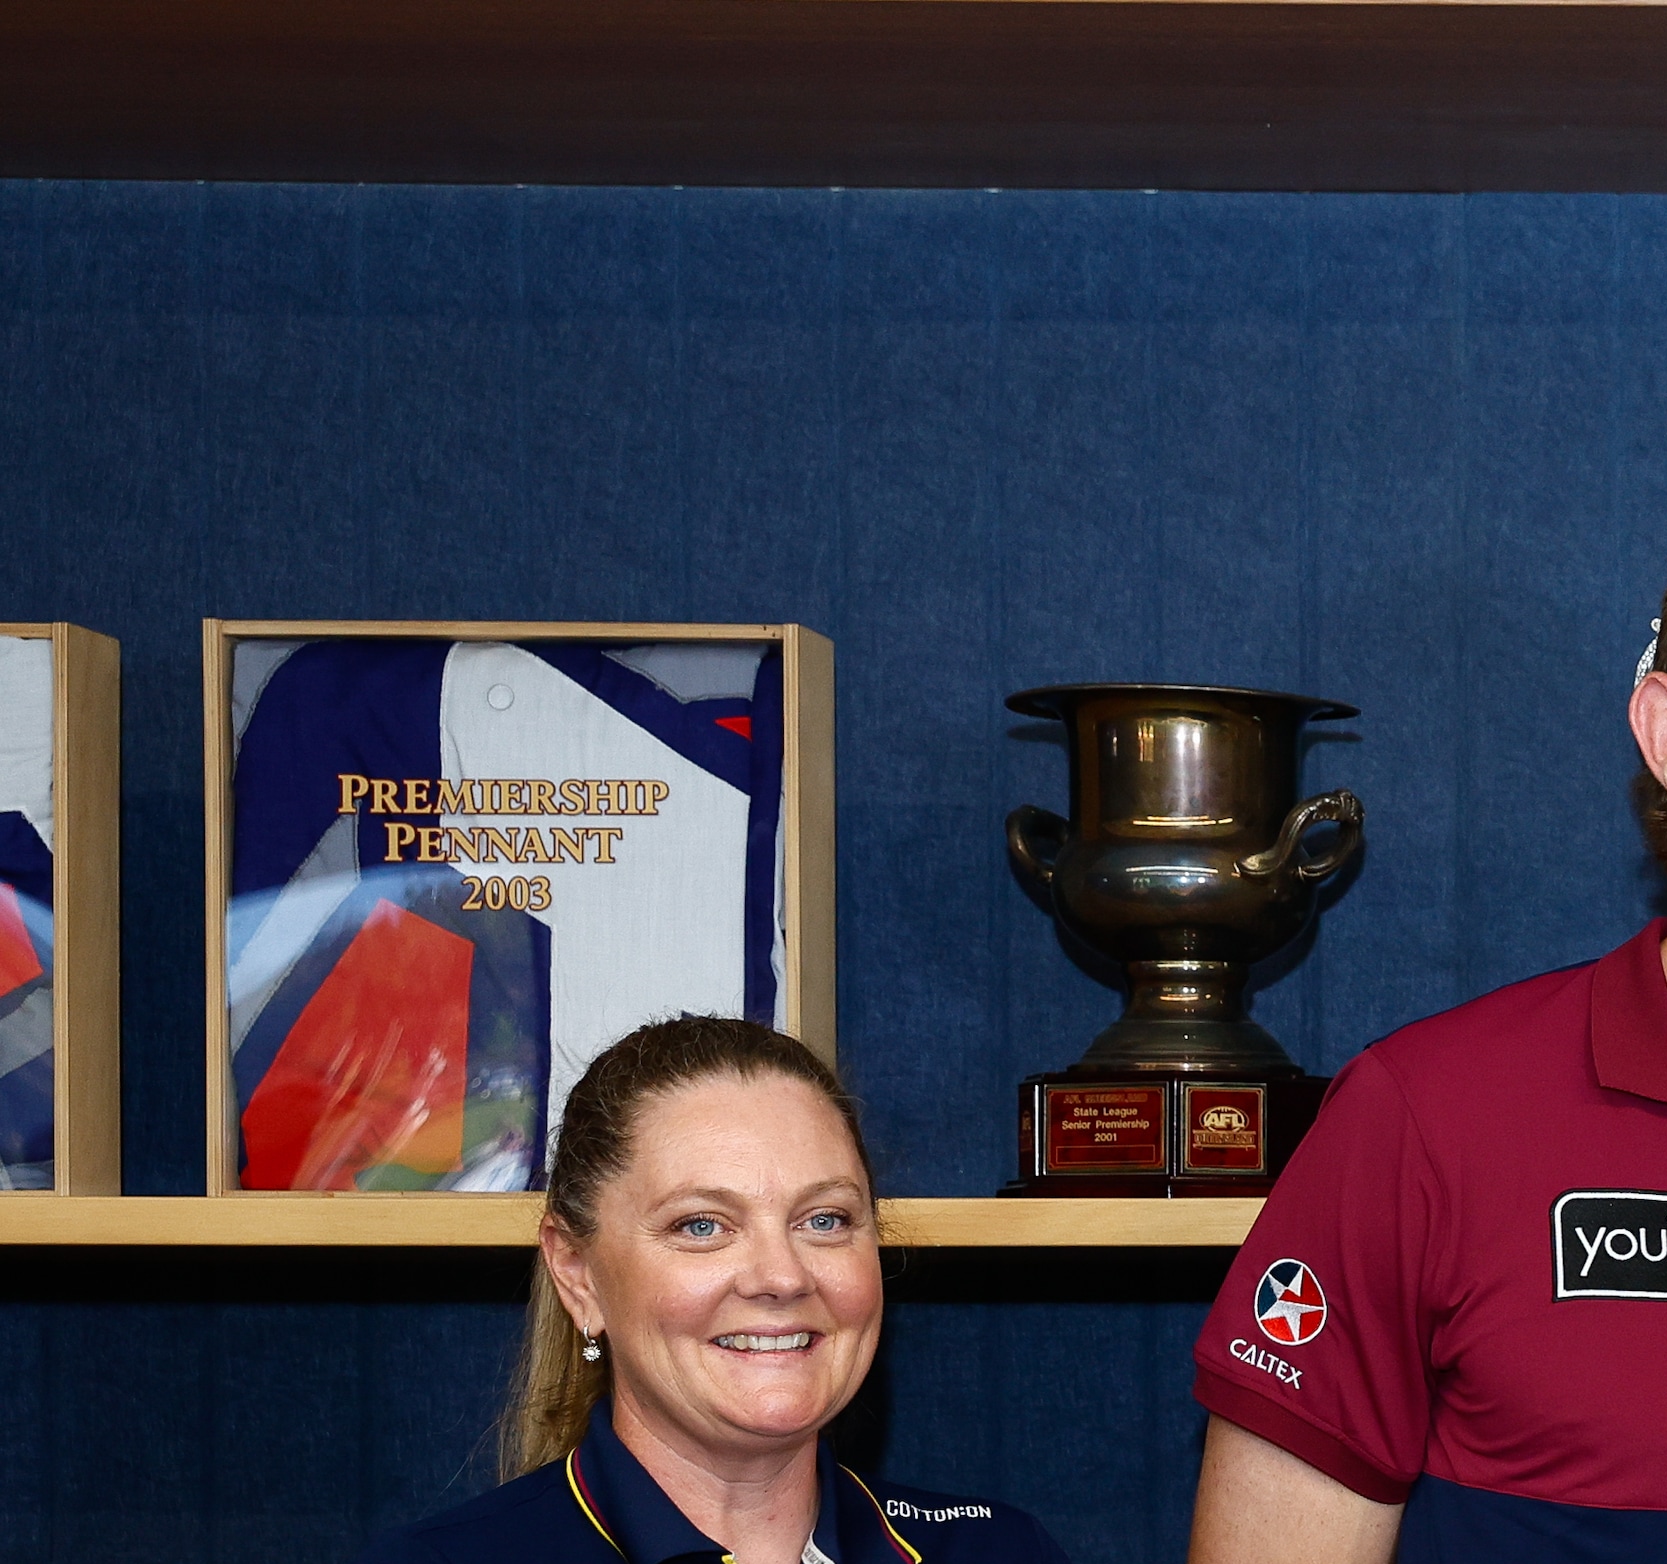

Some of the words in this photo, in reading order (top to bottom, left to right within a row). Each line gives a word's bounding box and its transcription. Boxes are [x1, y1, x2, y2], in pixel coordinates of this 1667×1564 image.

[337, 773, 670, 815] PREMIERSHIP
[383, 822, 624, 863] PENNANT
[461, 876, 553, 911] 2003
[1062, 1120, 1091, 1130] Senior
[1095, 1119, 1150, 1131] Premiership
[1073, 1107, 1099, 1117] State
[1103, 1107, 1138, 1118] League
[1204, 1112, 1246, 1128] AFL
[1094, 1133, 1118, 1142] 2001
[1229, 1338, 1303, 1390] CALTEX
